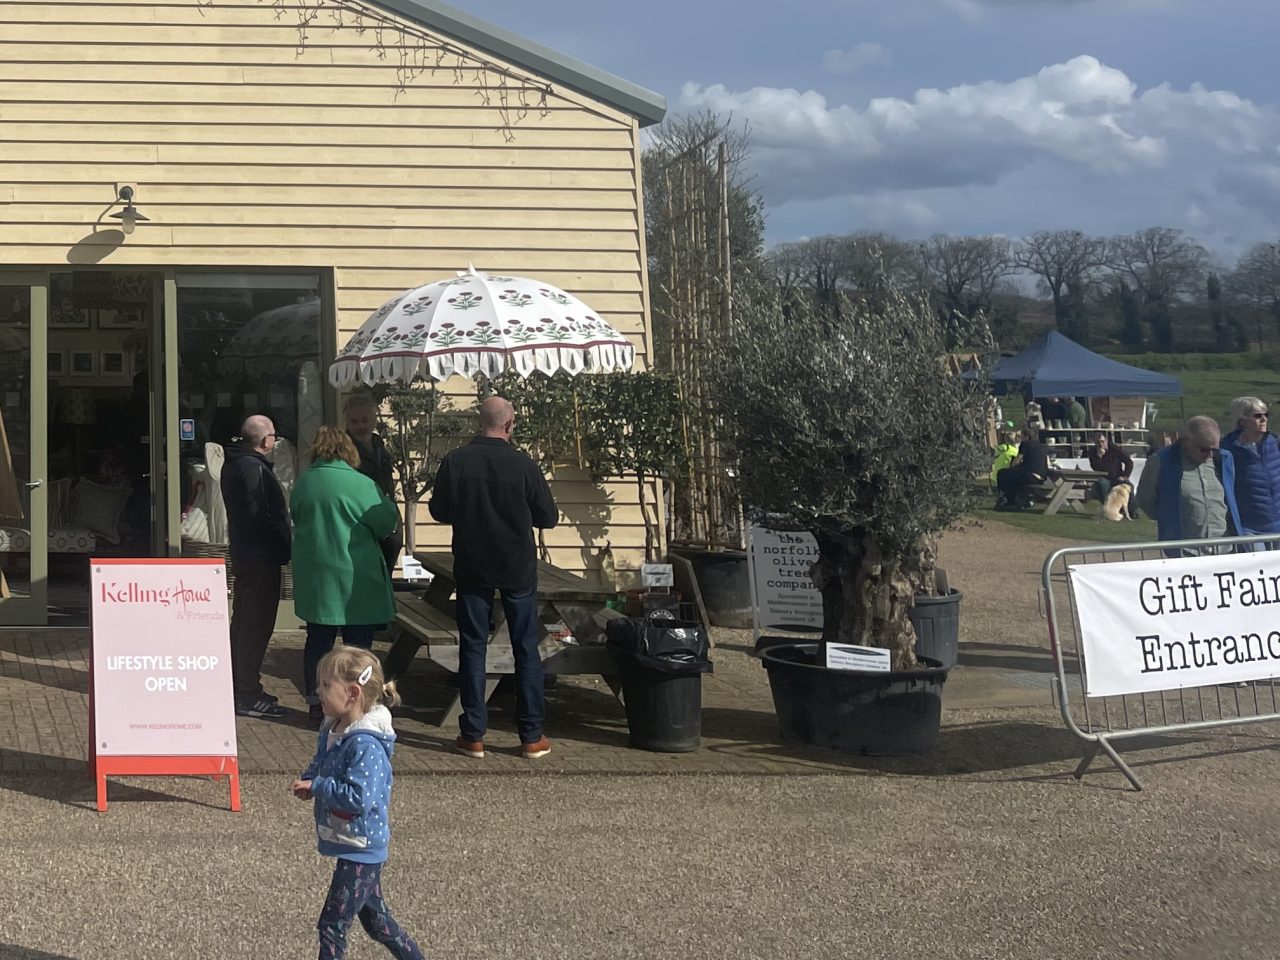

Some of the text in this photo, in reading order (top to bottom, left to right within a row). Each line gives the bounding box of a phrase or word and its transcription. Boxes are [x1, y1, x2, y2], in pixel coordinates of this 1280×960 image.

[779, 534, 803, 543] the
[763, 546, 820, 556] norfolk
[773, 556, 814, 566] olive
[779, 568, 810, 578] tree
[102, 579, 211, 614] Kelling Home
[1139, 574, 1208, 616] Gift
[187, 611, 225, 620] Friends
[107, 656, 219, 671] LIFESTYLE SHOP
[145, 676, 187, 691] OPEN
